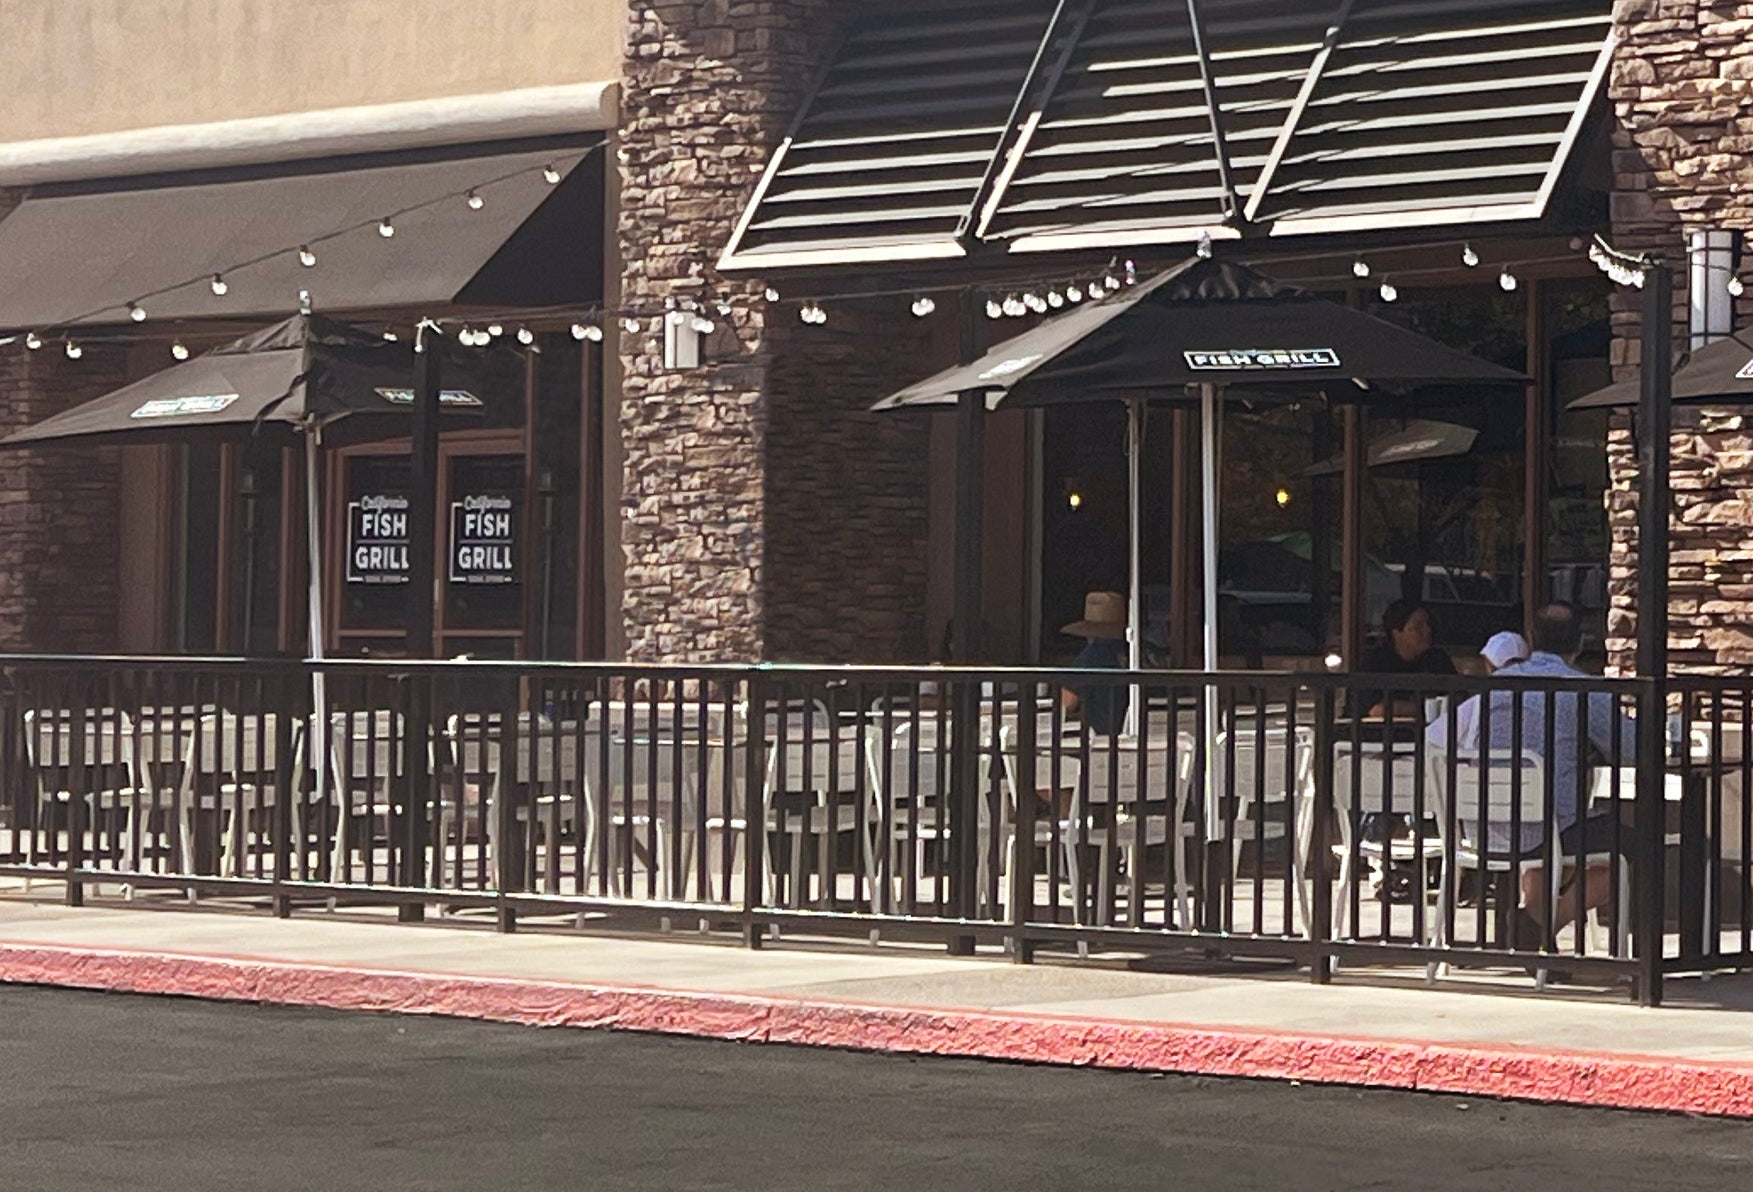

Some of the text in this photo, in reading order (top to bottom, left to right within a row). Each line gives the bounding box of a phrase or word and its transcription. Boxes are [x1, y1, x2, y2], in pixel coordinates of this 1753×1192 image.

[1194, 352, 1330, 366] FISH GRILL
[361, 513, 408, 537] FISH
[464, 513, 510, 537] FISH
[355, 546, 409, 570] GRILL
[458, 546, 513, 570] GRILL
